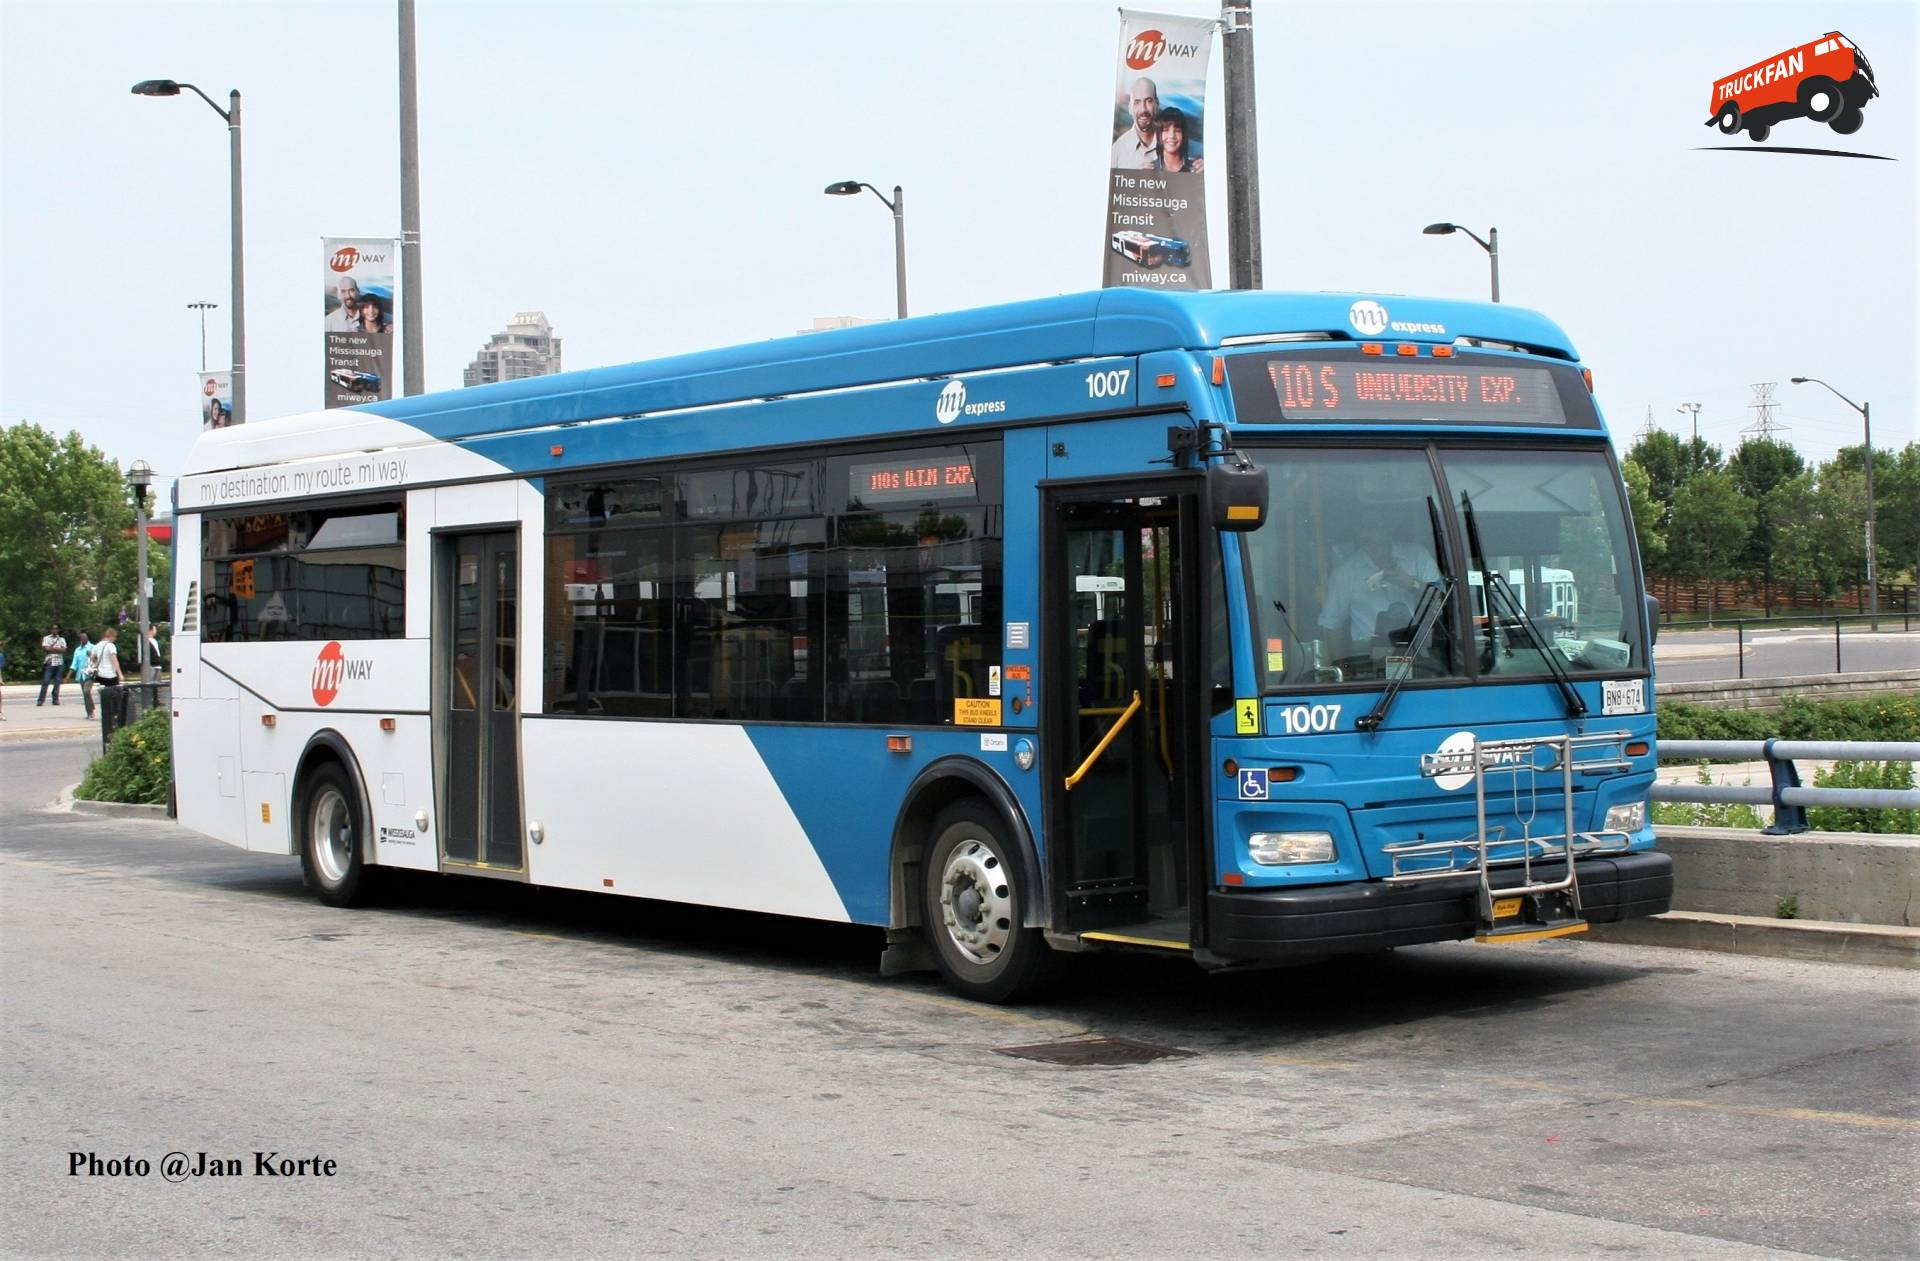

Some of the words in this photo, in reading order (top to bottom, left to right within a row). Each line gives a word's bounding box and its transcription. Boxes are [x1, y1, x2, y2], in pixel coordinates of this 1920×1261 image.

[1127, 36, 1165, 61] mi
[1168, 43, 1198, 58] WAY
[1114, 175, 1136, 189] The
[1139, 178, 1167, 190] new
[1112, 193, 1188, 211] Mississauga
[1112, 212, 1154, 226] Transit
[362, 255, 386, 263] WAY
[1122, 271, 1187, 286] miway.ca
[1391, 320, 1446, 335] express
[329, 335, 347, 344] The
[329, 347, 382, 357] Mississauga
[329, 357, 359, 367] Transit
[1085, 370, 1130, 398] 1007
[1320, 366, 1339, 408] S
[1355, 372, 1468, 402] UNIVERSITY
[1481, 376, 1521, 403] EXP.
[337, 393, 378, 403] miway.ca
[965, 400, 1006, 416] express
[200, 483, 218, 504] my
[221, 474, 290, 500] destination.
[294, 472, 315, 495] my
[316, 464, 354, 488] route.
[358, 458, 376, 483] mi
[379, 459, 409, 485] way.
[347, 660, 373, 680] WAY
[966, 700, 990, 708] CAUTION
[1280, 704, 1341, 734] 1007
